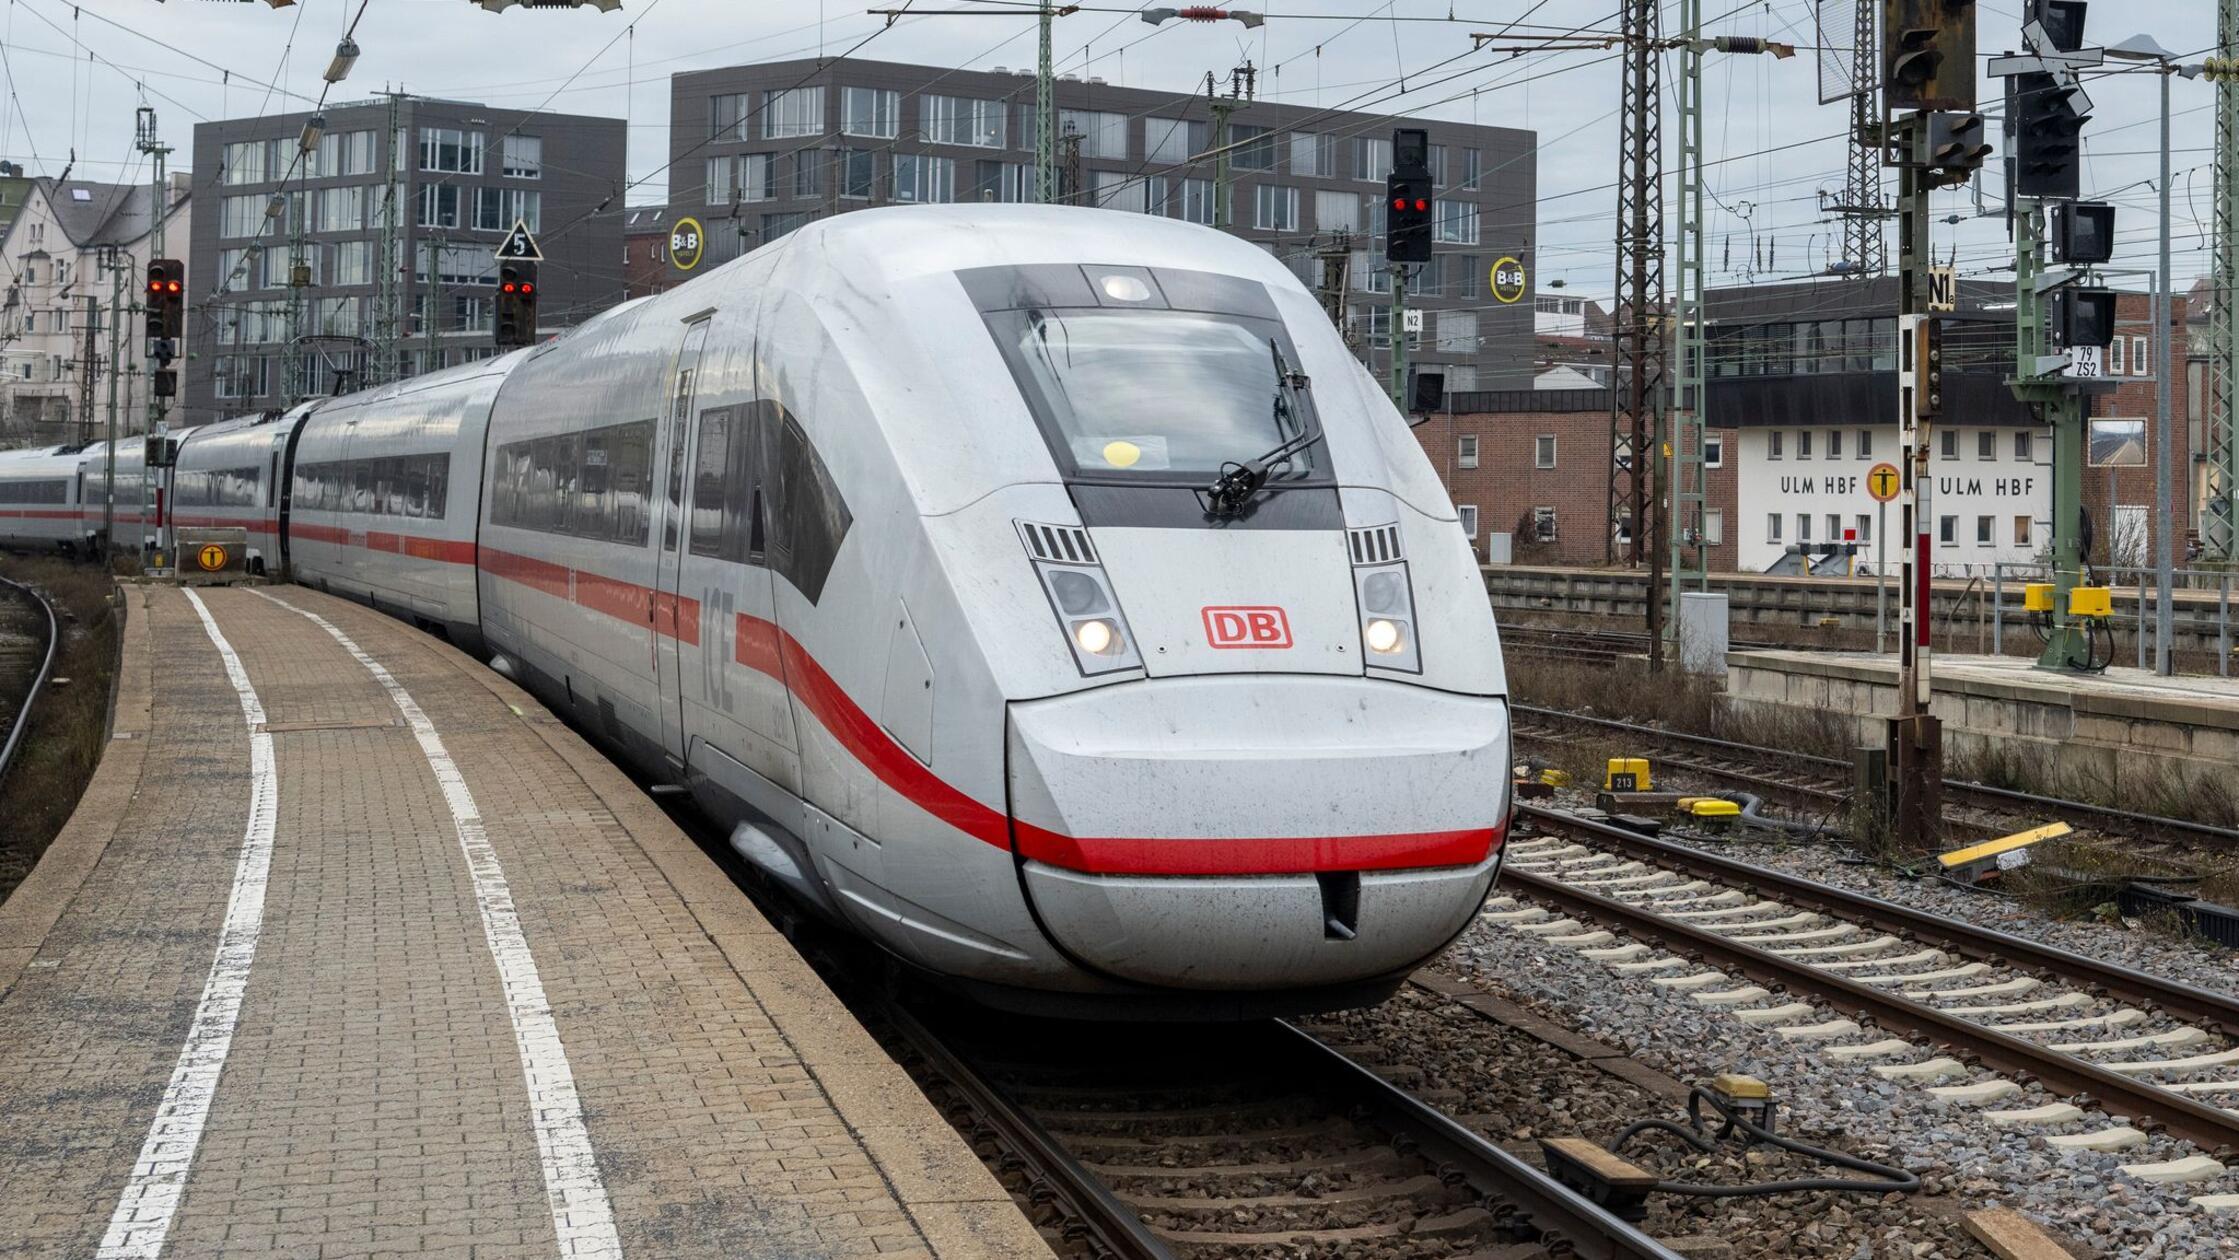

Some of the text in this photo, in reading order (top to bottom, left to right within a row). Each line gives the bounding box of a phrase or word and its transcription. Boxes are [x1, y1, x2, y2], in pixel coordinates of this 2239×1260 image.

[513, 233, 526, 256] 5
[672, 233, 698, 250] B&B
[1496, 270, 1523, 286] B&B
[1407, 315, 1419, 327] N2
[2080, 346, 2093, 361] 79
[2076, 361, 2097, 377] ZS2
[1781, 476, 1857, 494] ULM HBF
[1940, 477, 2034, 496] ULM HBF
[1213, 613, 1282, 642] DB
[702, 586, 734, 714] ICE
[1616, 777, 1632, 788] 213
